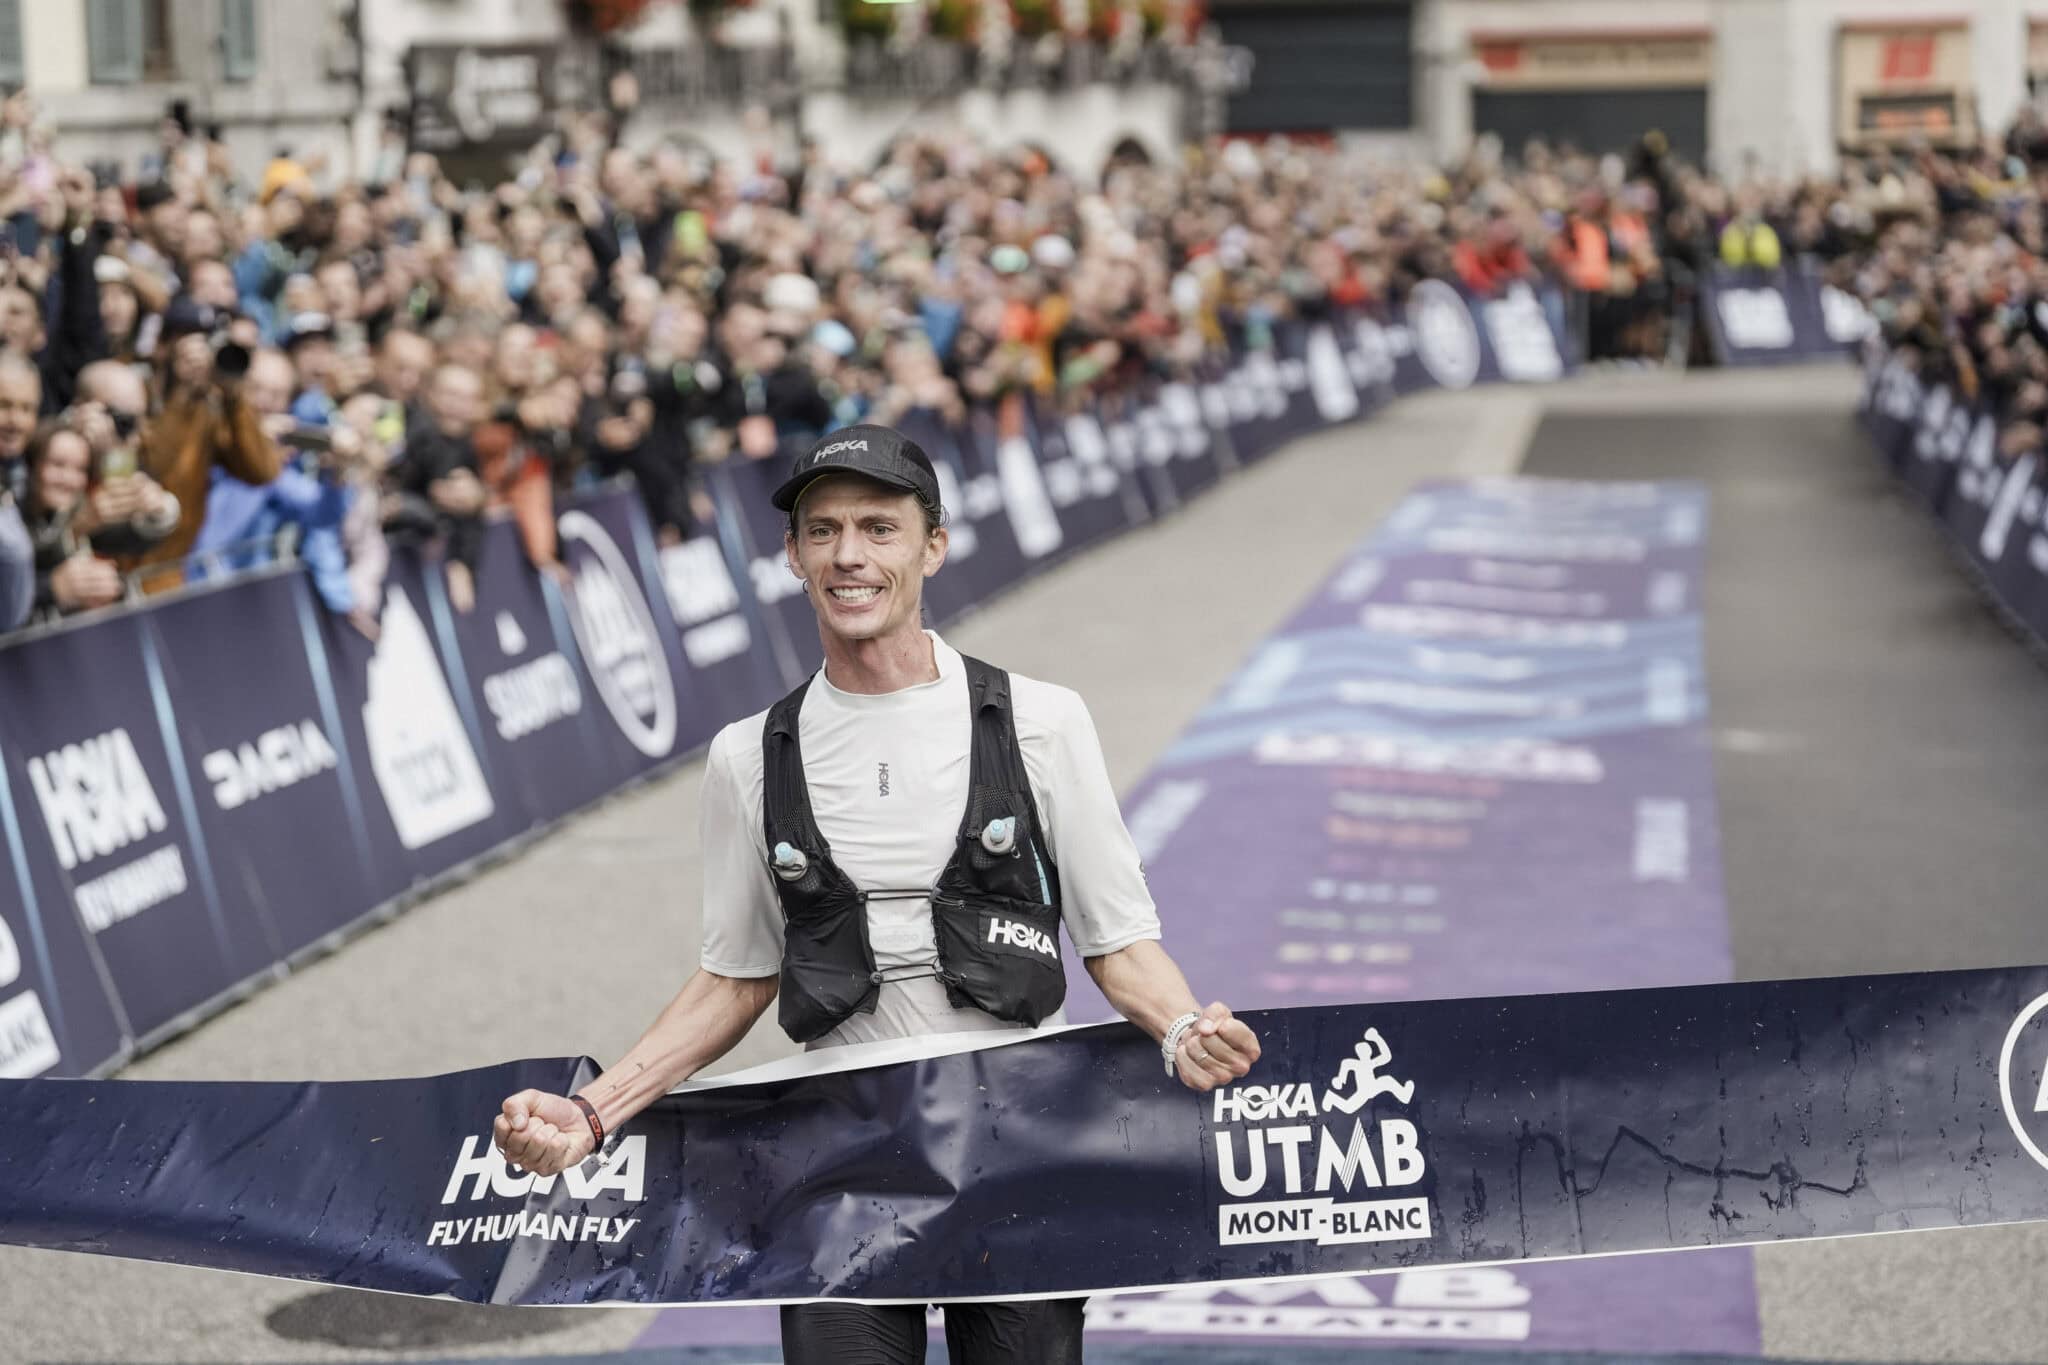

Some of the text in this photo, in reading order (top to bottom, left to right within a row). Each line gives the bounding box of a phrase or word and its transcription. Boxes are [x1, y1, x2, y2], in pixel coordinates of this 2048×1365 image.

[813, 440, 868, 463] HOKA
[878, 762, 890, 798] HOKA
[987, 917, 1058, 960] HOKA
[1213, 1082, 1318, 1123] HOKA
[1214, 1117, 1426, 1198] UTMB
[426, 1217, 473, 1246] FLY
[579, 1216, 638, 1243] FLY
